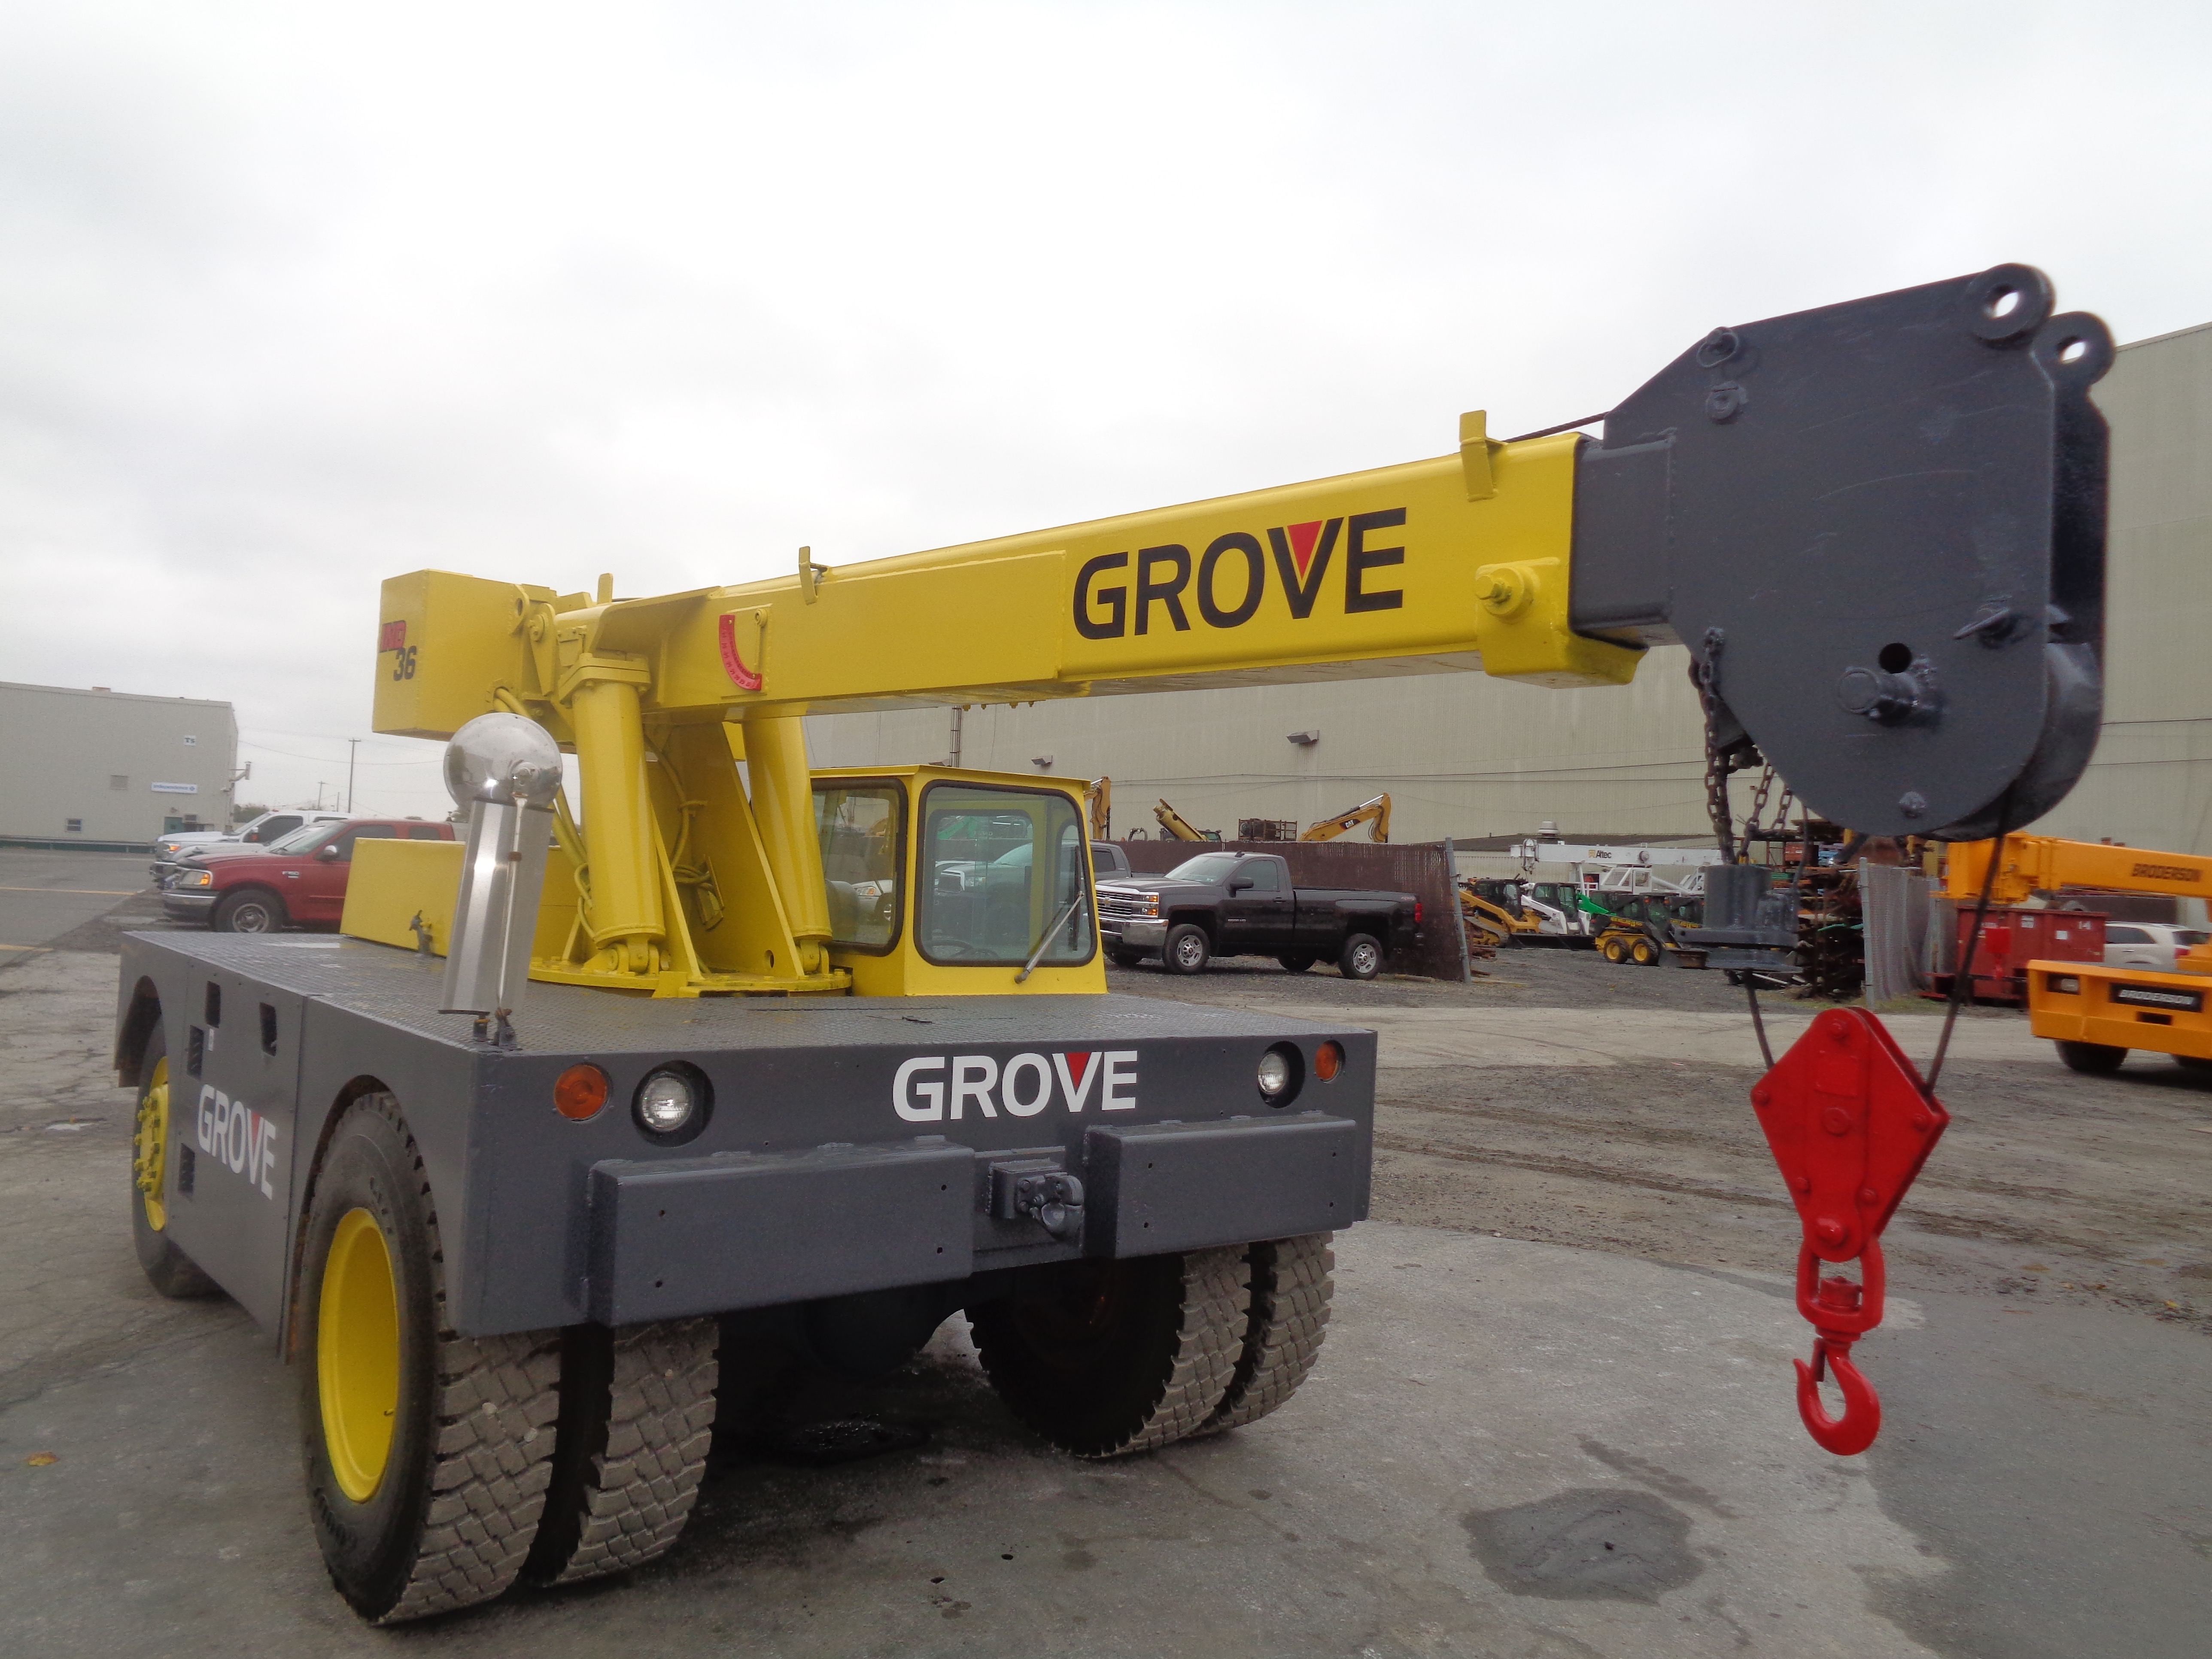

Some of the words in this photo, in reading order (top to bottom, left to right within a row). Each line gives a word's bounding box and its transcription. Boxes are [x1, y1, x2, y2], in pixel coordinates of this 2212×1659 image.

[1073, 507, 1407, 640] GROVE
[380, 620, 406, 653] IND
[393, 645, 417, 681] 36
[1345, 820, 1354, 828] CAT
[1596, 850, 1612, 858] Altec
[2132, 863, 2202, 882] BRODERSON
[2118, 989, 2195, 1005] BRODERSON
[893, 1051, 1137, 1122] GROVE
[198, 1084, 276, 1200] GROVE
